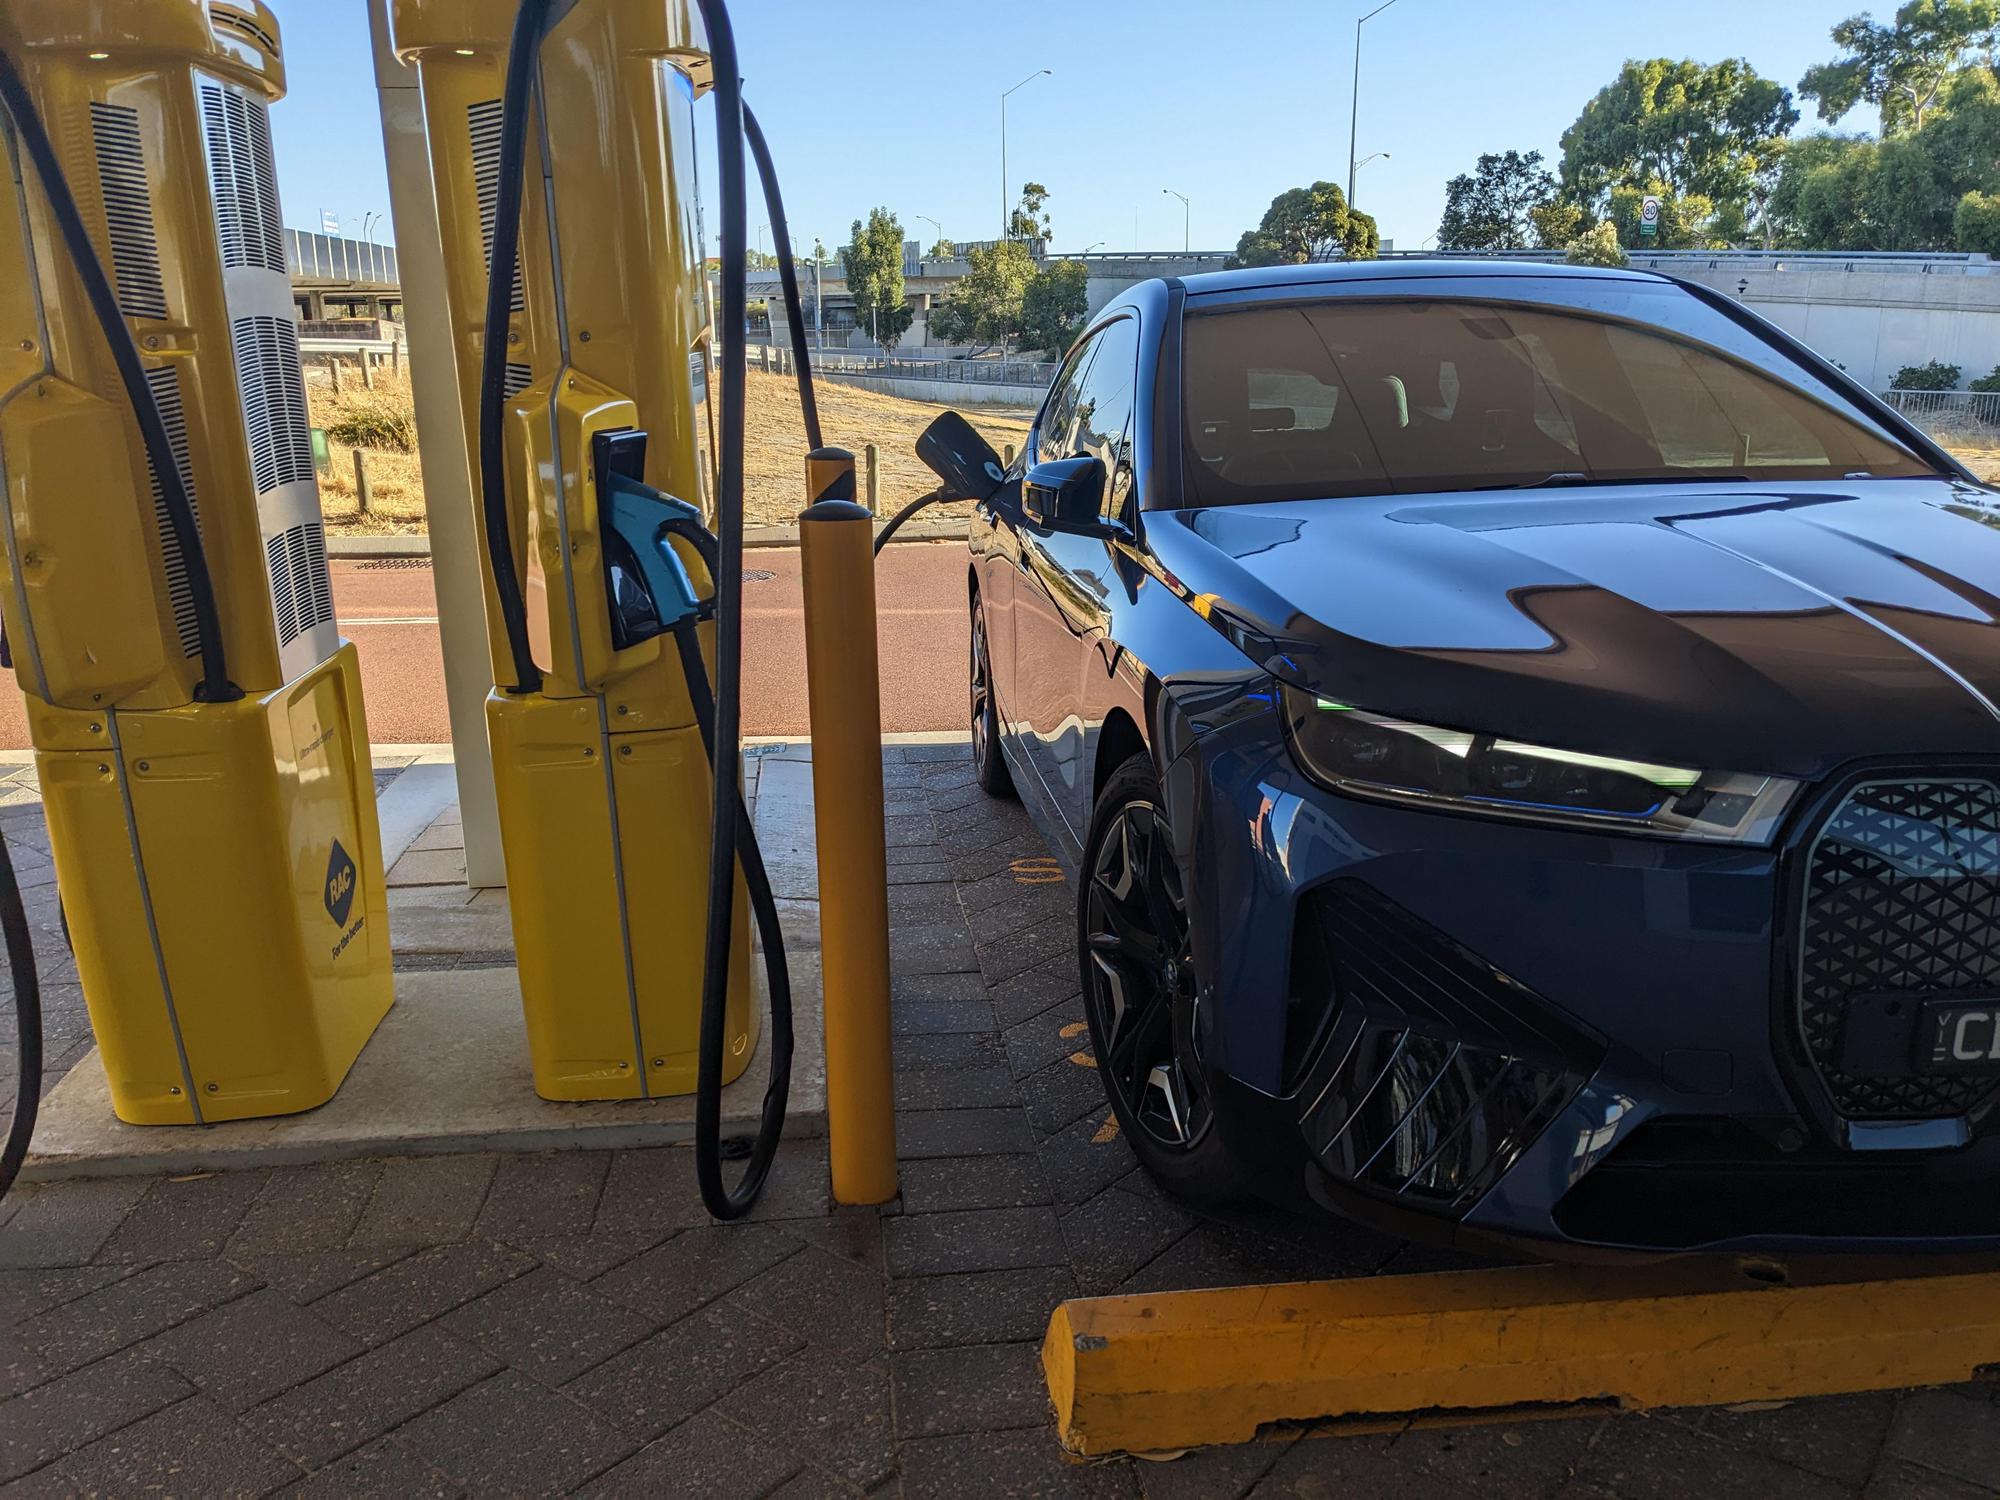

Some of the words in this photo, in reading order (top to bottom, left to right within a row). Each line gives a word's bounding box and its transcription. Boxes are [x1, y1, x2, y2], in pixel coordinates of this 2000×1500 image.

[1645, 205, 1656, 215] 80
[329, 864, 351, 906] RAC
[332, 943, 341, 960] For
[341, 934, 350, 950] the
[349, 916, 364, 940] better
